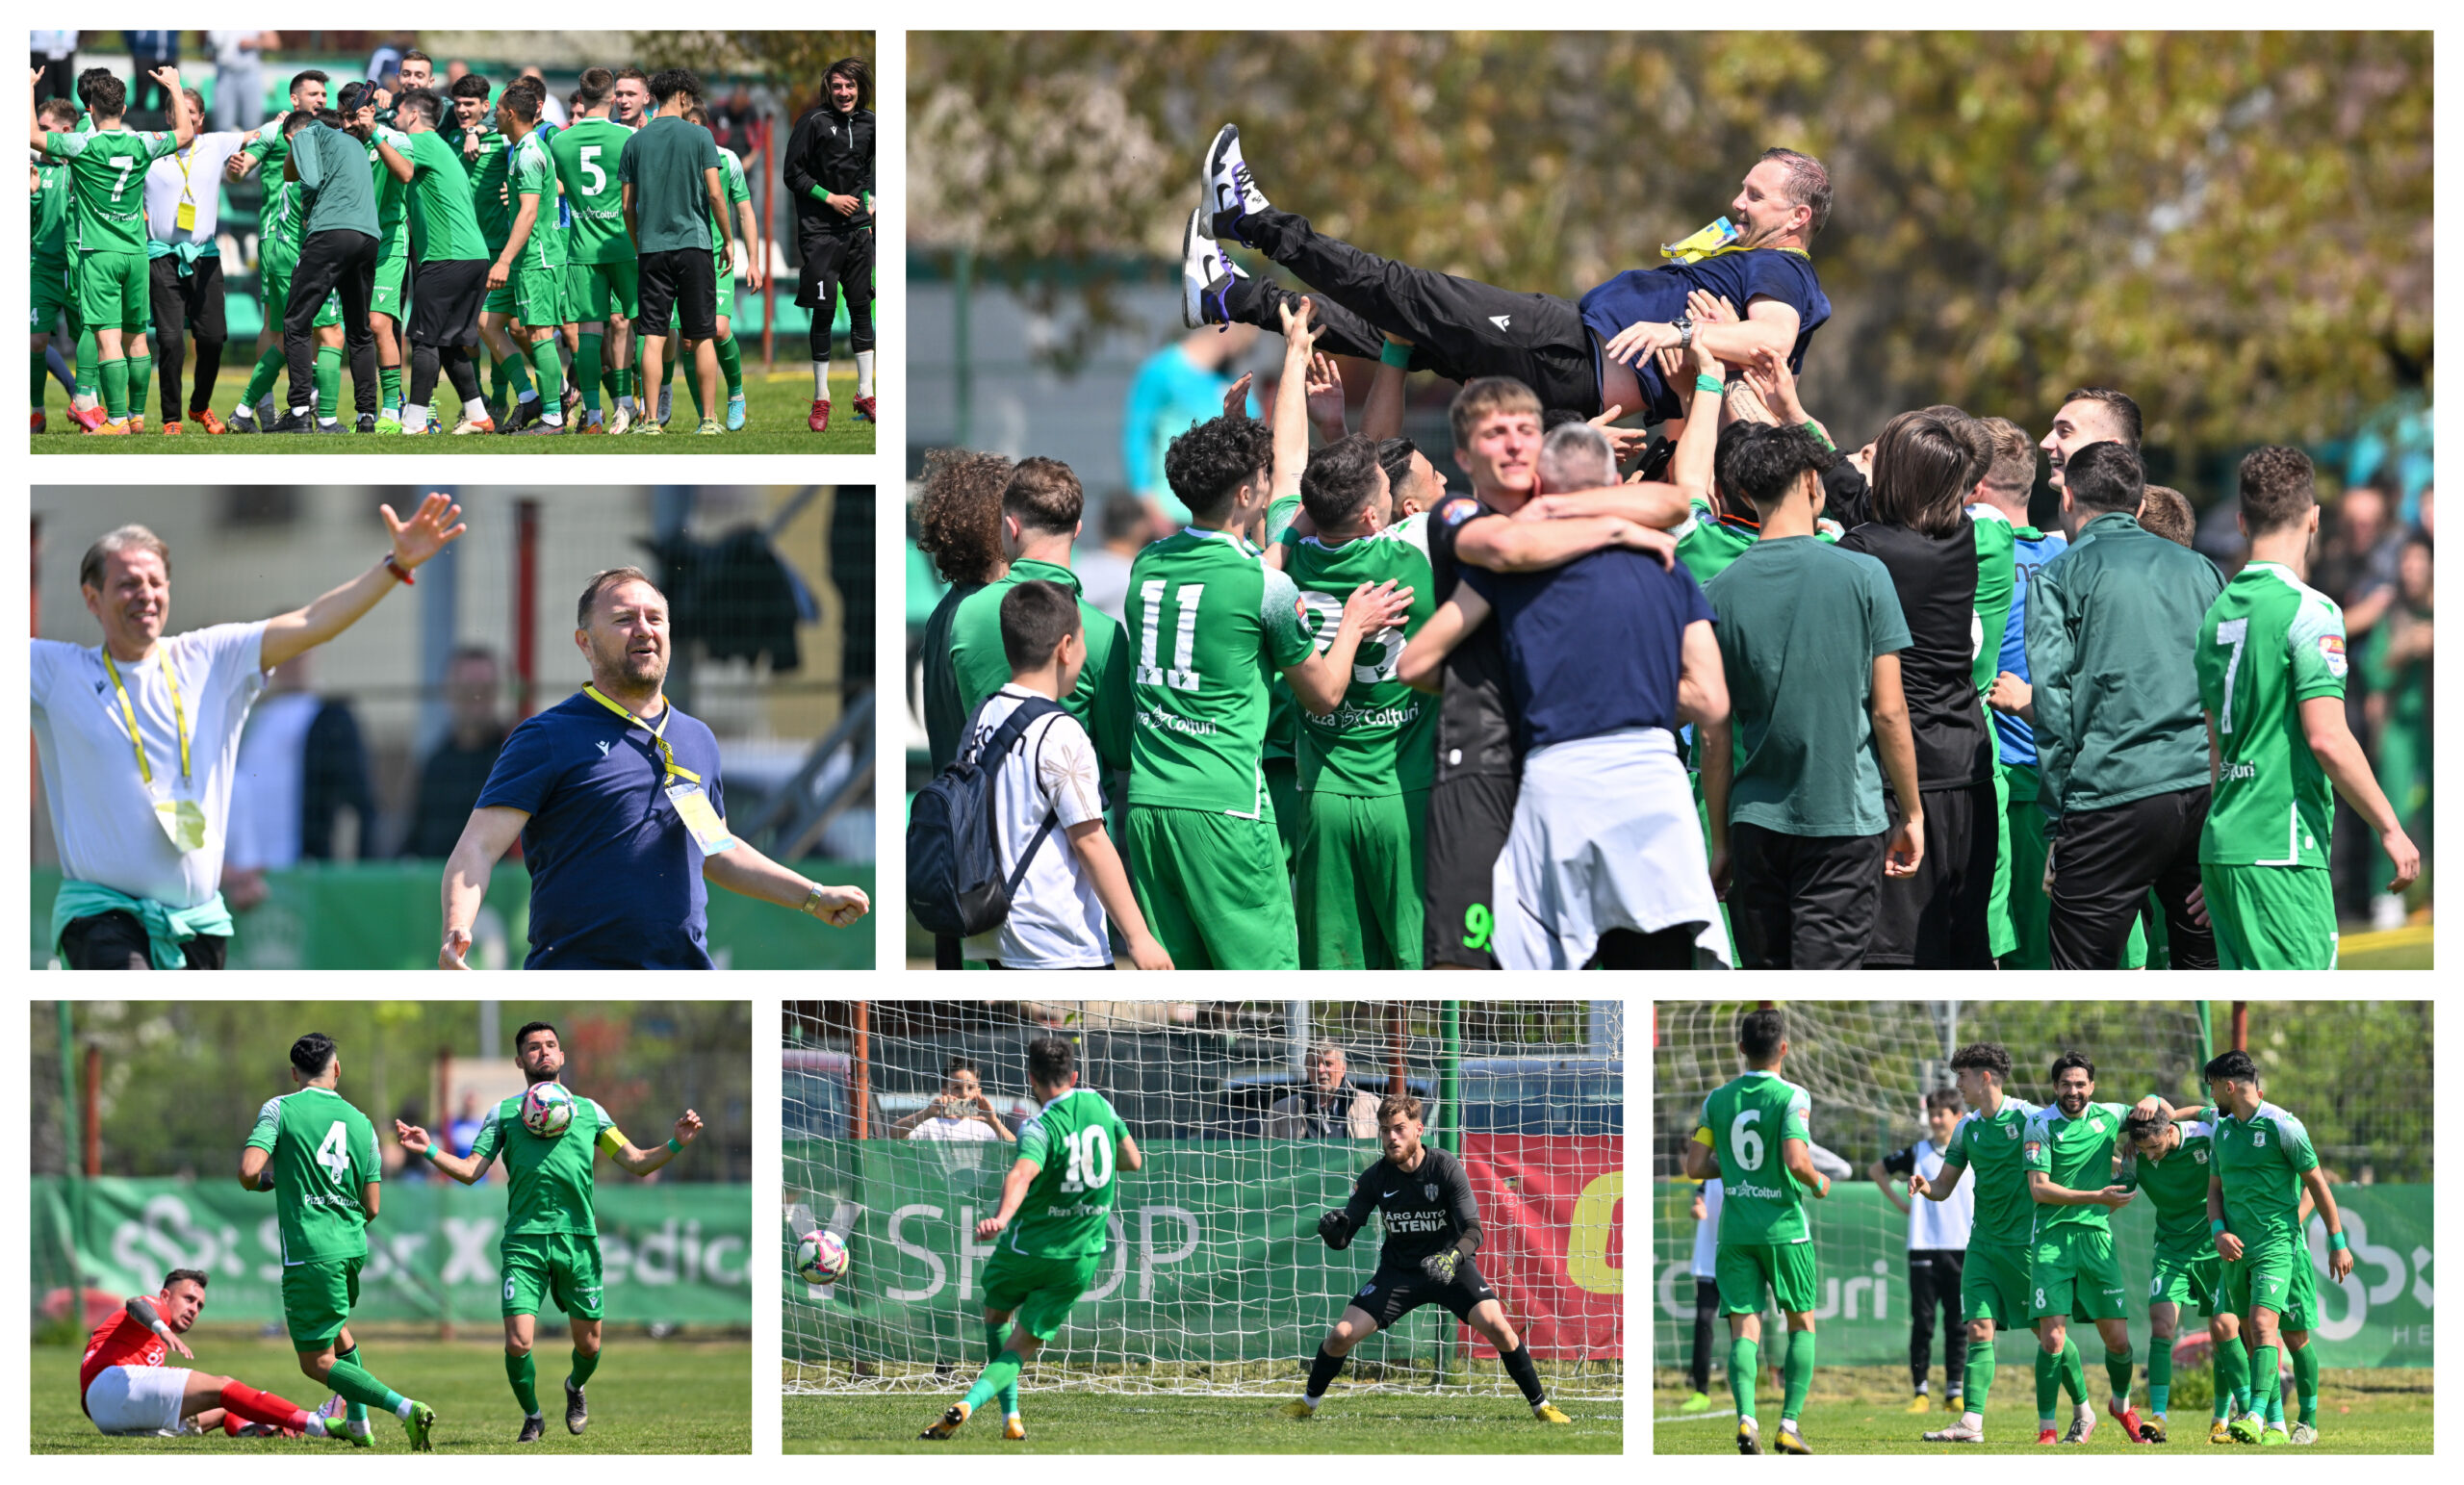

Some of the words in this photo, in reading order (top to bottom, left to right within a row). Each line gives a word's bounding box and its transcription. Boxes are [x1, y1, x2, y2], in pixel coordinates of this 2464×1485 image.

[109, 155, 134, 202] 7
[580, 145, 606, 196] 5
[817, 280, 826, 300] 1
[1136, 579, 1205, 691] 11
[2217, 617, 2248, 734] 7
[1167, 715, 1218, 736] Colțuri
[1364, 702, 1419, 729] Colțuri
[1463, 903, 1495, 953] 9
[317, 1120, 350, 1185] 4
[1061, 1124, 1113, 1192] 10
[1731, 1109, 1764, 1171] 6
[1383, 1211, 1412, 1221] ÂRG
[1414, 1209, 1447, 1220] AUTO
[503, 1276, 516, 1300] 6
[2035, 1288, 2046, 1310] 8
